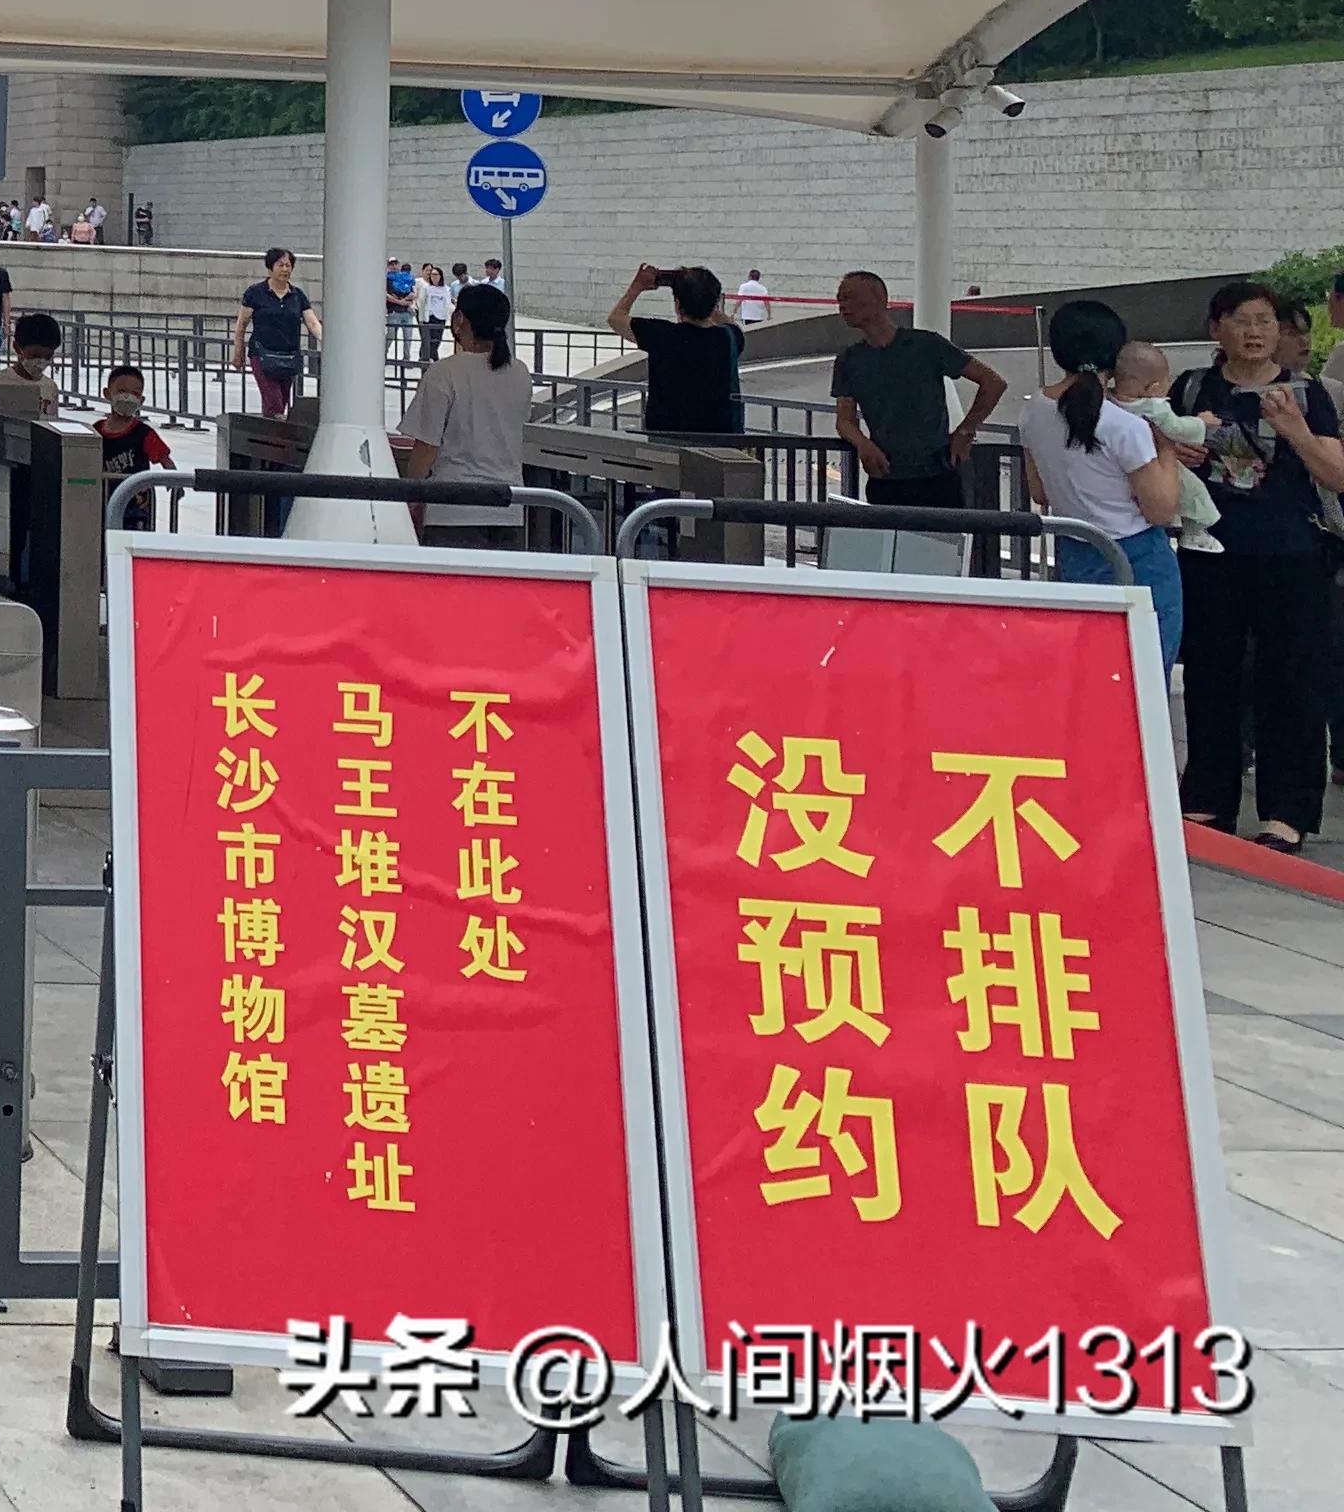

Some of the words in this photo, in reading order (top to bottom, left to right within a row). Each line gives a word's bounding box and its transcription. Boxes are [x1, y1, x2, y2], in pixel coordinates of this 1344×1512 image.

[213, 673, 288, 1125] 长沙市博物馆
[332, 681, 417, 1214] 马王堆汉墓遗址
[449, 690, 528, 983] 不在此处
[725, 730, 903, 1223] 没预约
[931, 751, 1123, 1241] 不排队
